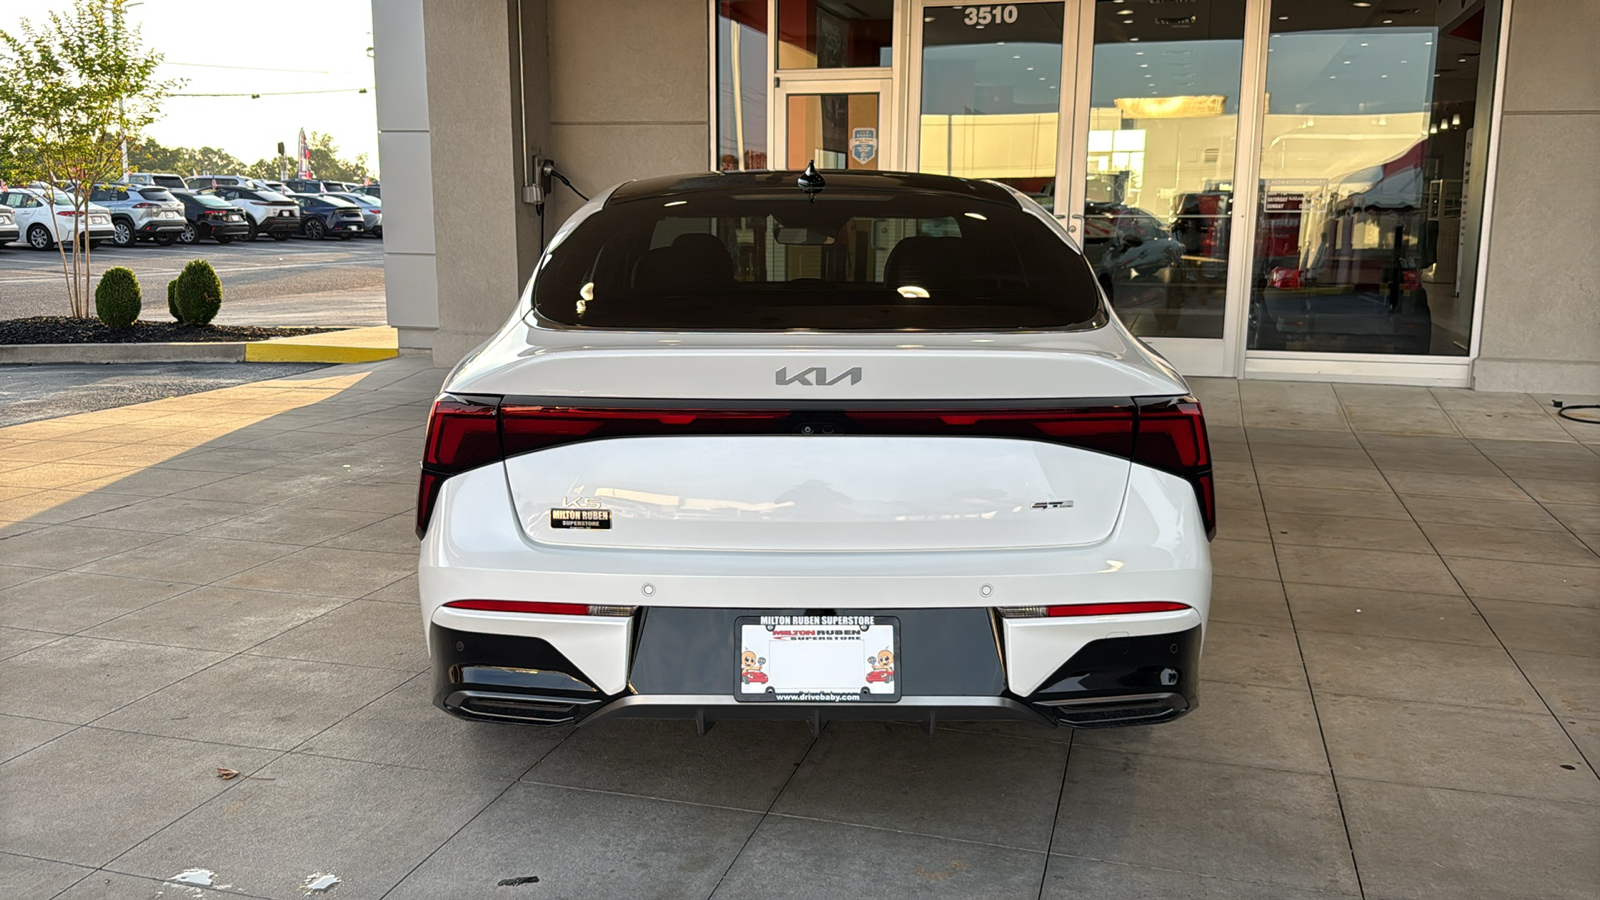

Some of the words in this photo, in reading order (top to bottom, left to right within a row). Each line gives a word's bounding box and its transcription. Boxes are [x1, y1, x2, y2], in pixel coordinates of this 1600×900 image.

[964, 5, 1018, 26] 3510
[552, 510, 581, 520] MILTON
[582, 510, 608, 521] RUBEN
[760, 616, 791, 625] MILTON
[792, 616, 820, 625] RUBEN
[821, 616, 875, 625] SUPERSTORE
[776, 693, 860, 702] www.drivebaby.com
